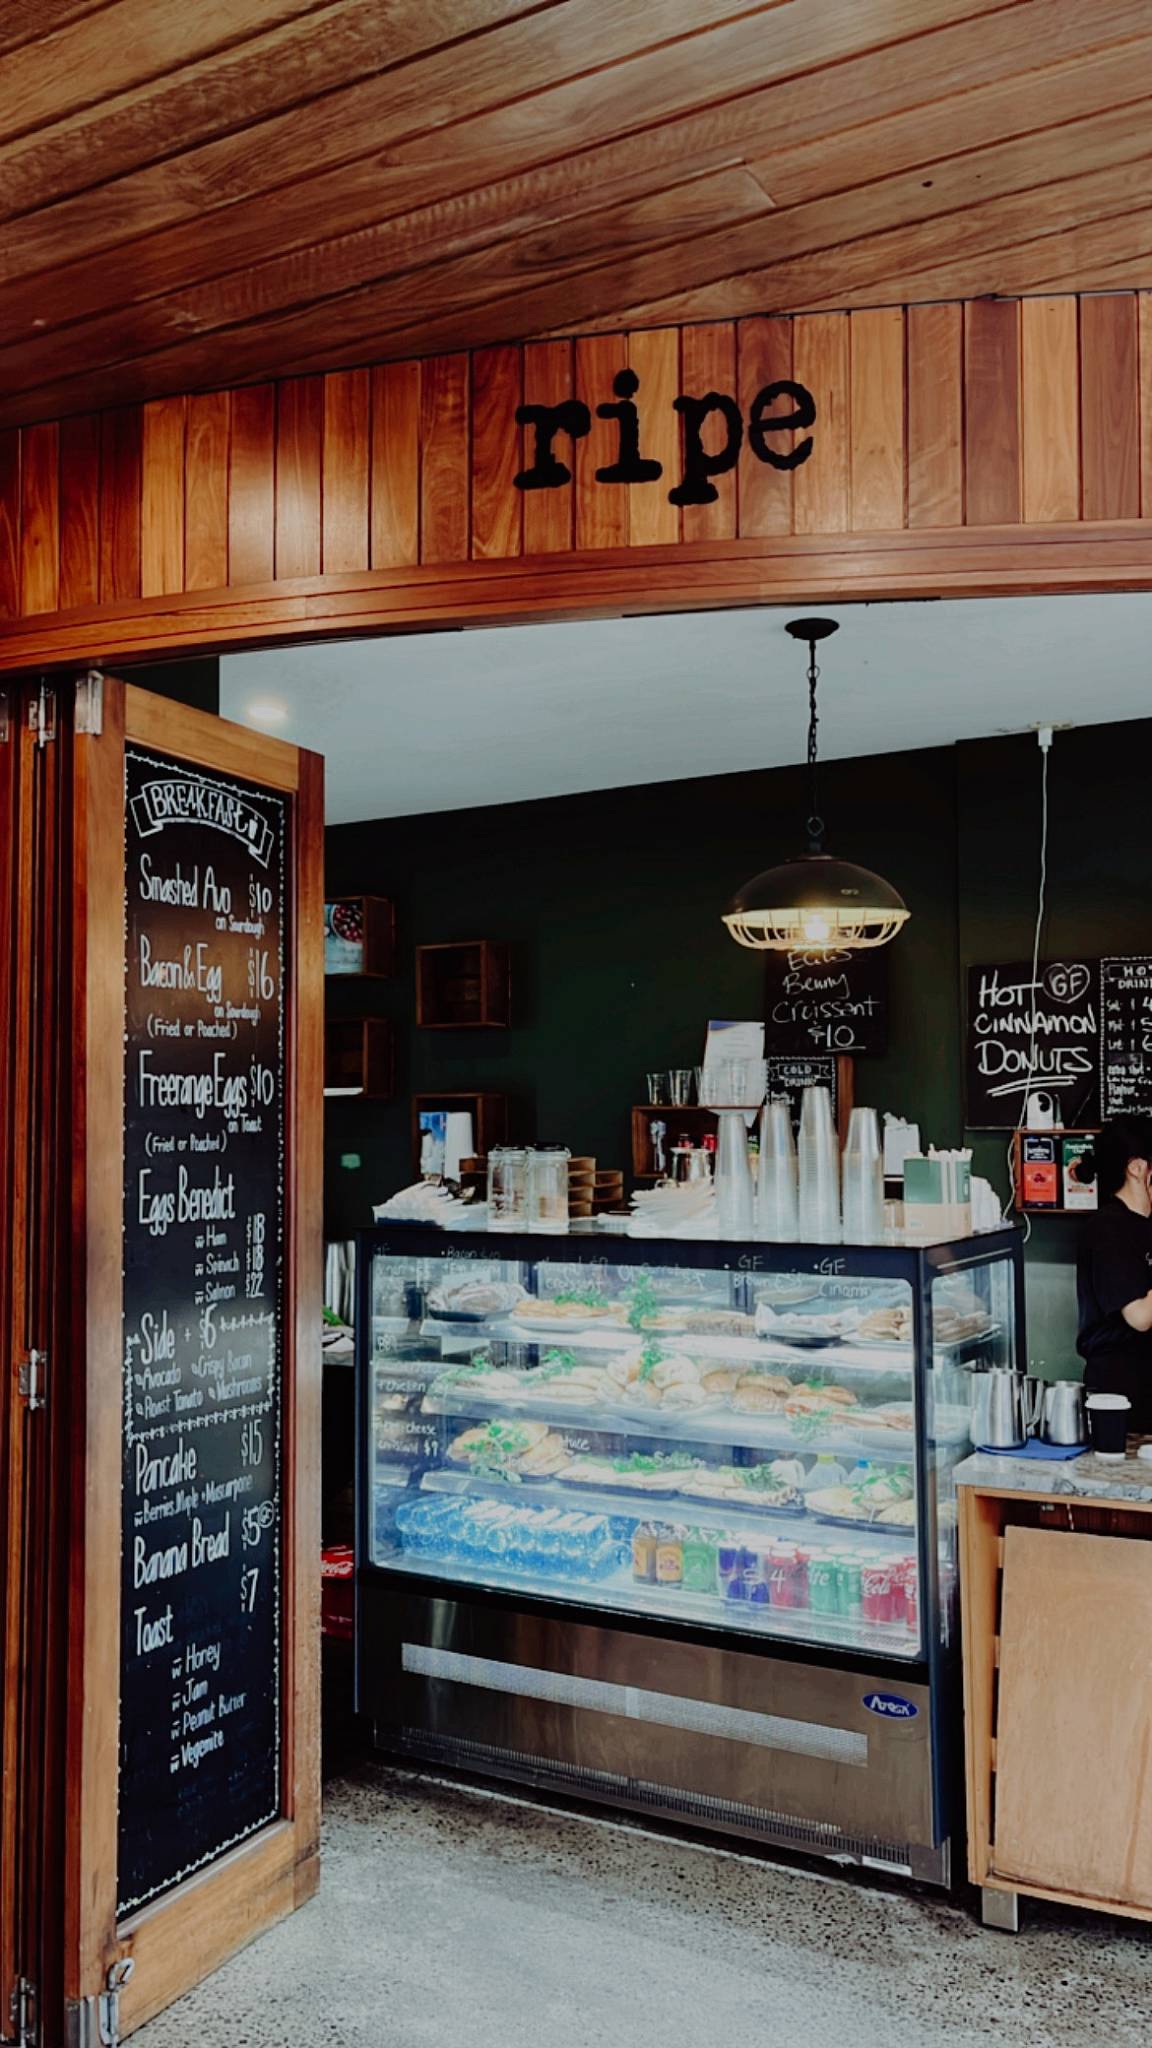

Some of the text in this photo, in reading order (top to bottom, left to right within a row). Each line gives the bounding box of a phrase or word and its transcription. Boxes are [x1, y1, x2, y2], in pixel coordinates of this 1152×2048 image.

[513, 367, 816, 506] ripe
[140, 853, 272, 918] Smashed Avo $10
[215, 917, 227, 931] on
[140, 934, 182, 987] Bacon
[196, 943, 222, 1003] Egg
[248, 947, 274, 1000] $16
[782, 973, 851, 1000] Benny
[1051, 972, 1083, 997] GF
[1117, 978, 1152, 990] DRIN
[214, 1005, 224, 1018] on
[772, 995, 881, 1024] Croissant
[974, 1002, 1097, 1036] CINNAMON
[184, 1023, 195, 1036] or
[807, 1021, 856, 1048] $10
[784, 1063, 812, 1075] COLD
[974, 1039, 1094, 1076] DONUTS
[214, 1052, 247, 1118] Eggs
[250, 1054, 274, 1108] $10
[228, 1113, 262, 1133] on Toast
[178, 1138, 187, 1150] or
[139, 1164, 236, 1236] Eggs Benedict
[206, 1225, 228, 1248] Ham
[206, 1251, 239, 1274] Spinach
[738, 1254, 763, 1270] GF
[820, 1257, 846, 1275] GF
[205, 1281, 236, 1303] Salmon
[141, 1309, 176, 1365] Side
[200, 1303, 217, 1350] $6
[135, 1419, 263, 1496] Pancake $15
[134, 1535, 188, 1590] Banana
[192, 1510, 230, 1569] Bread
[241, 1505, 262, 1550] $5
[240, 1564, 259, 1613] $7
[134, 1604, 174, 1656] Toast
[185, 1642, 221, 1673] Honey
[182, 1678, 209, 1706] Jam
[182, 1701, 215, 1736] Peanut
[181, 1729, 225, 1769] Vegemite
